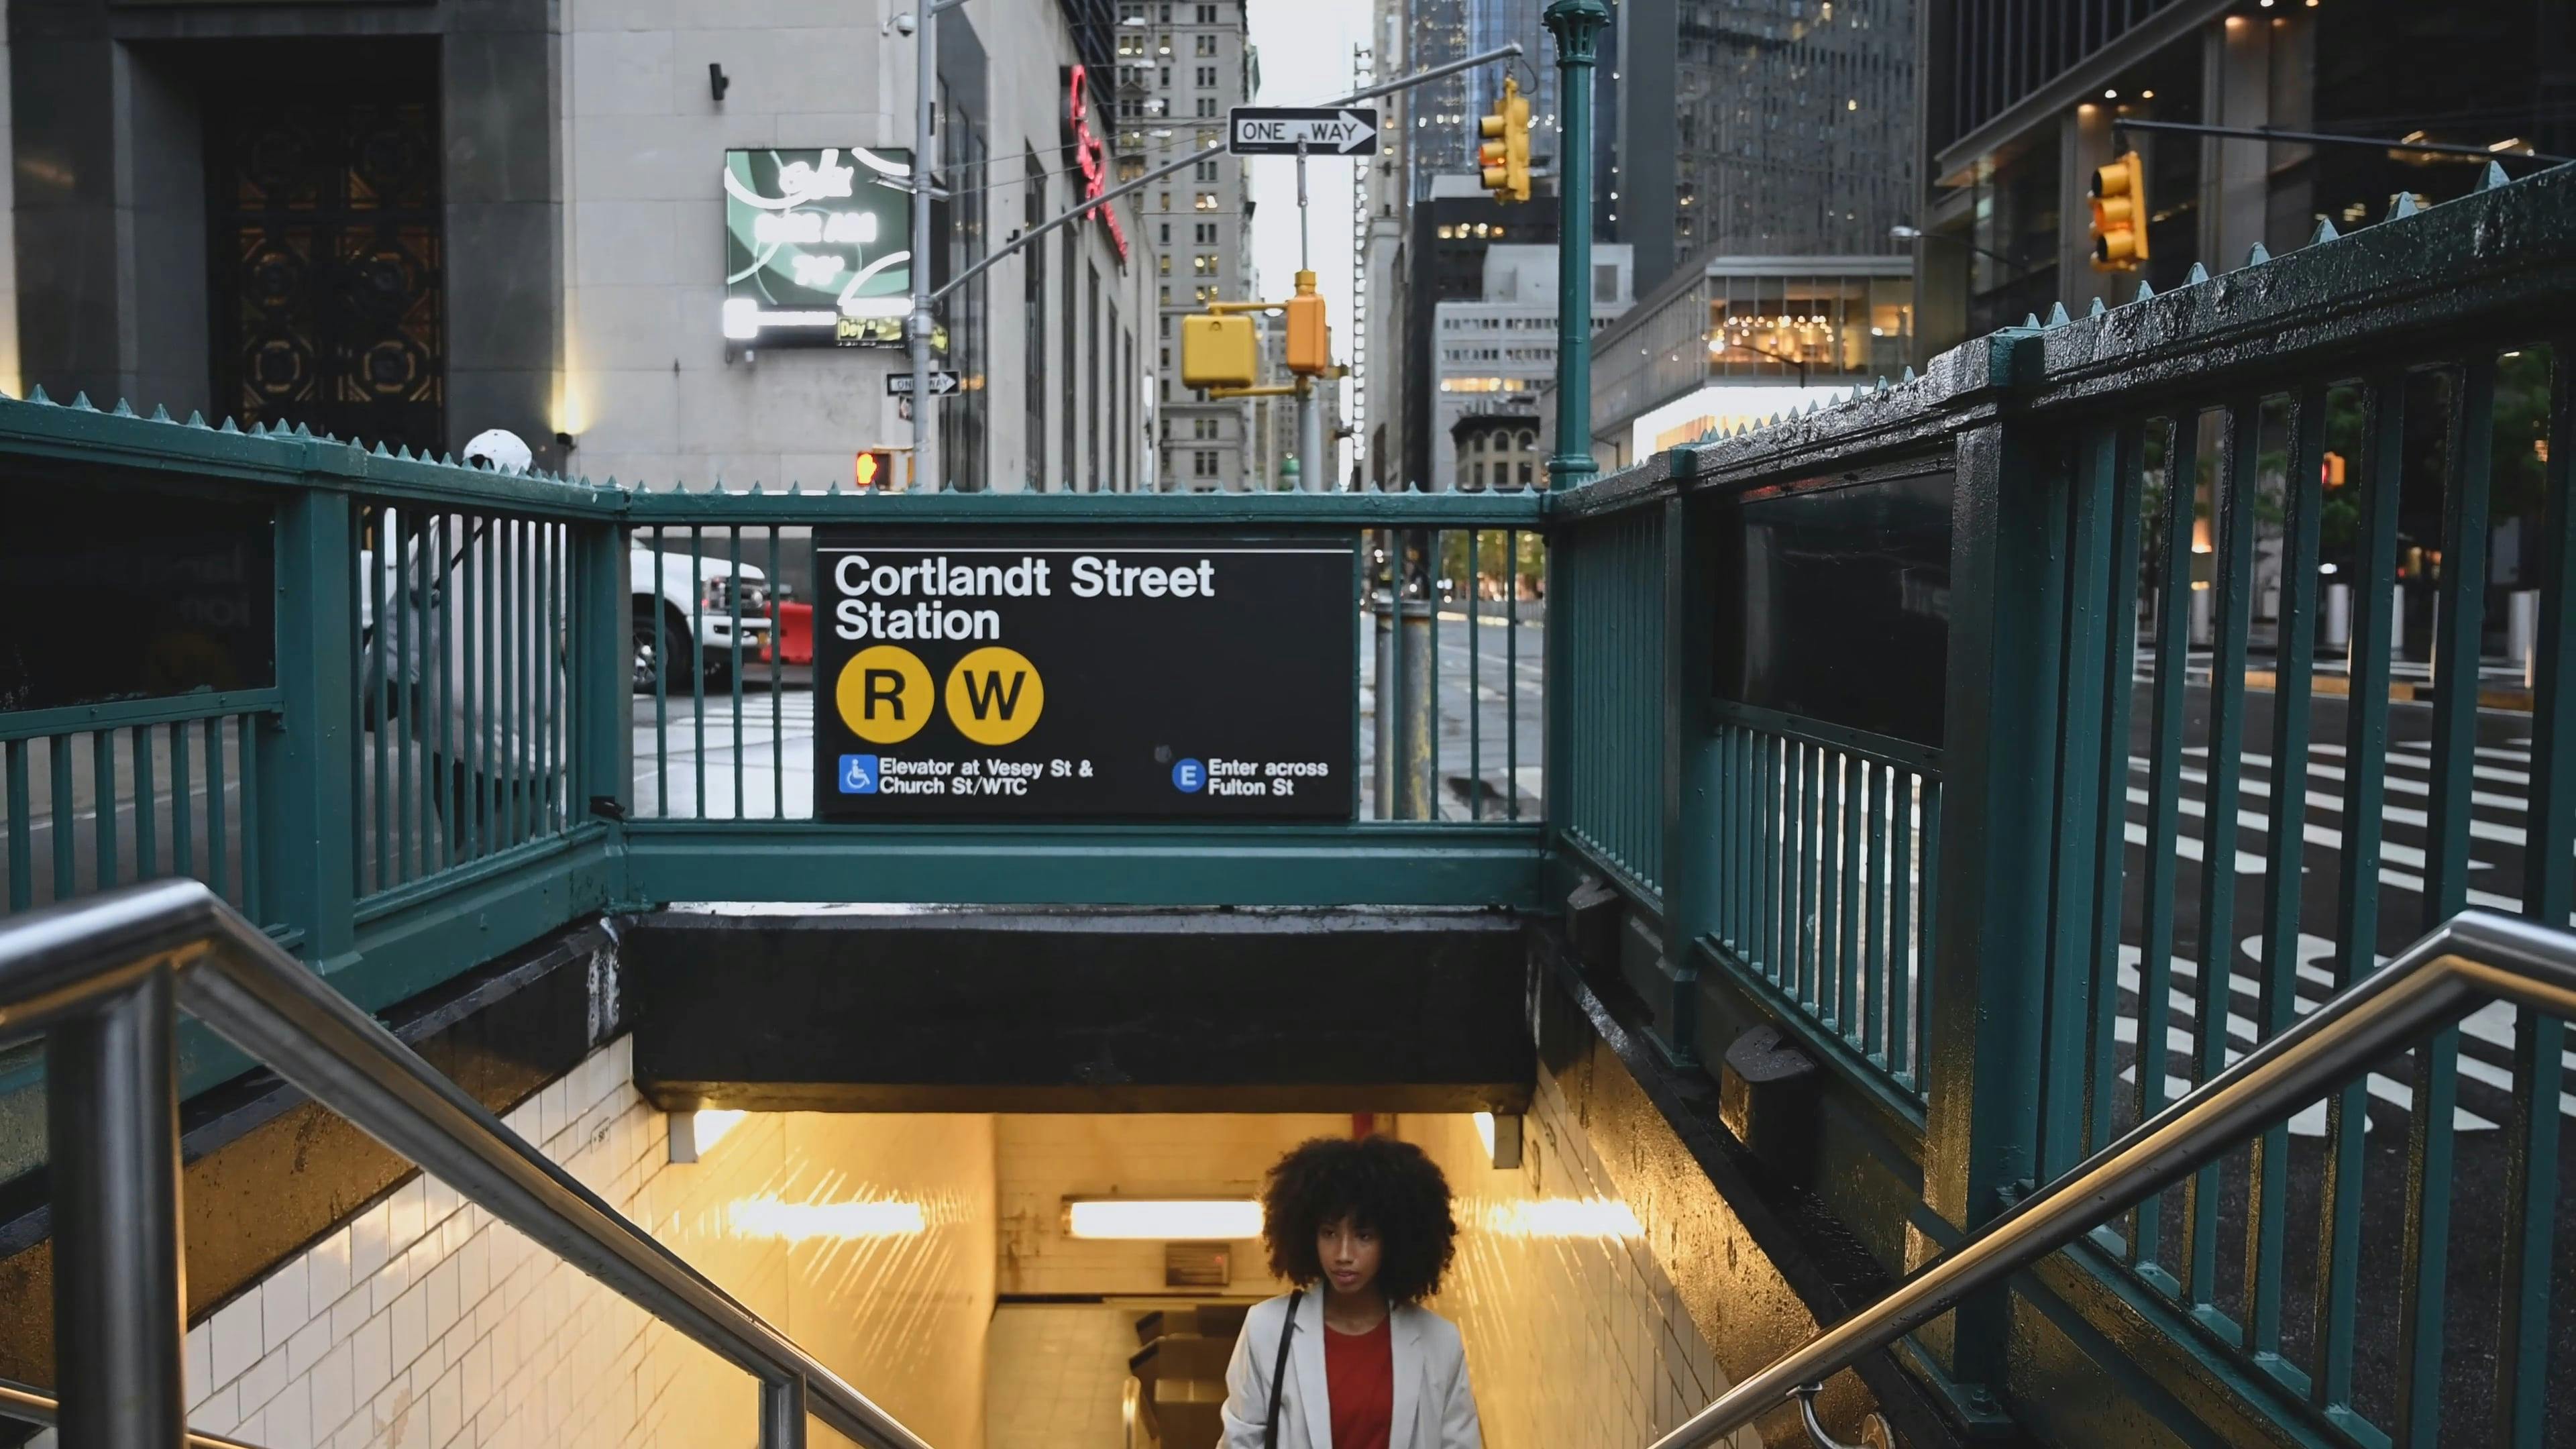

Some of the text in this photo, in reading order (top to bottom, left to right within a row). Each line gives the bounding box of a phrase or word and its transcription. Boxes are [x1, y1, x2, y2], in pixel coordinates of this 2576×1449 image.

[1243, 122, 1357, 141] ONE WAY
[835, 555, 1215, 598] Cortlandt Street
[835, 599, 1000, 641] Station
[864, 669, 1025, 720] R W
[880, 758, 1093, 779] Elevator at Vesey St &
[1181, 765, 1197, 786] E
[1209, 759, 1328, 776] Enter across
[880, 776, 1028, 796] Church St/WTC
[1209, 778, 1294, 796] Fulton St
